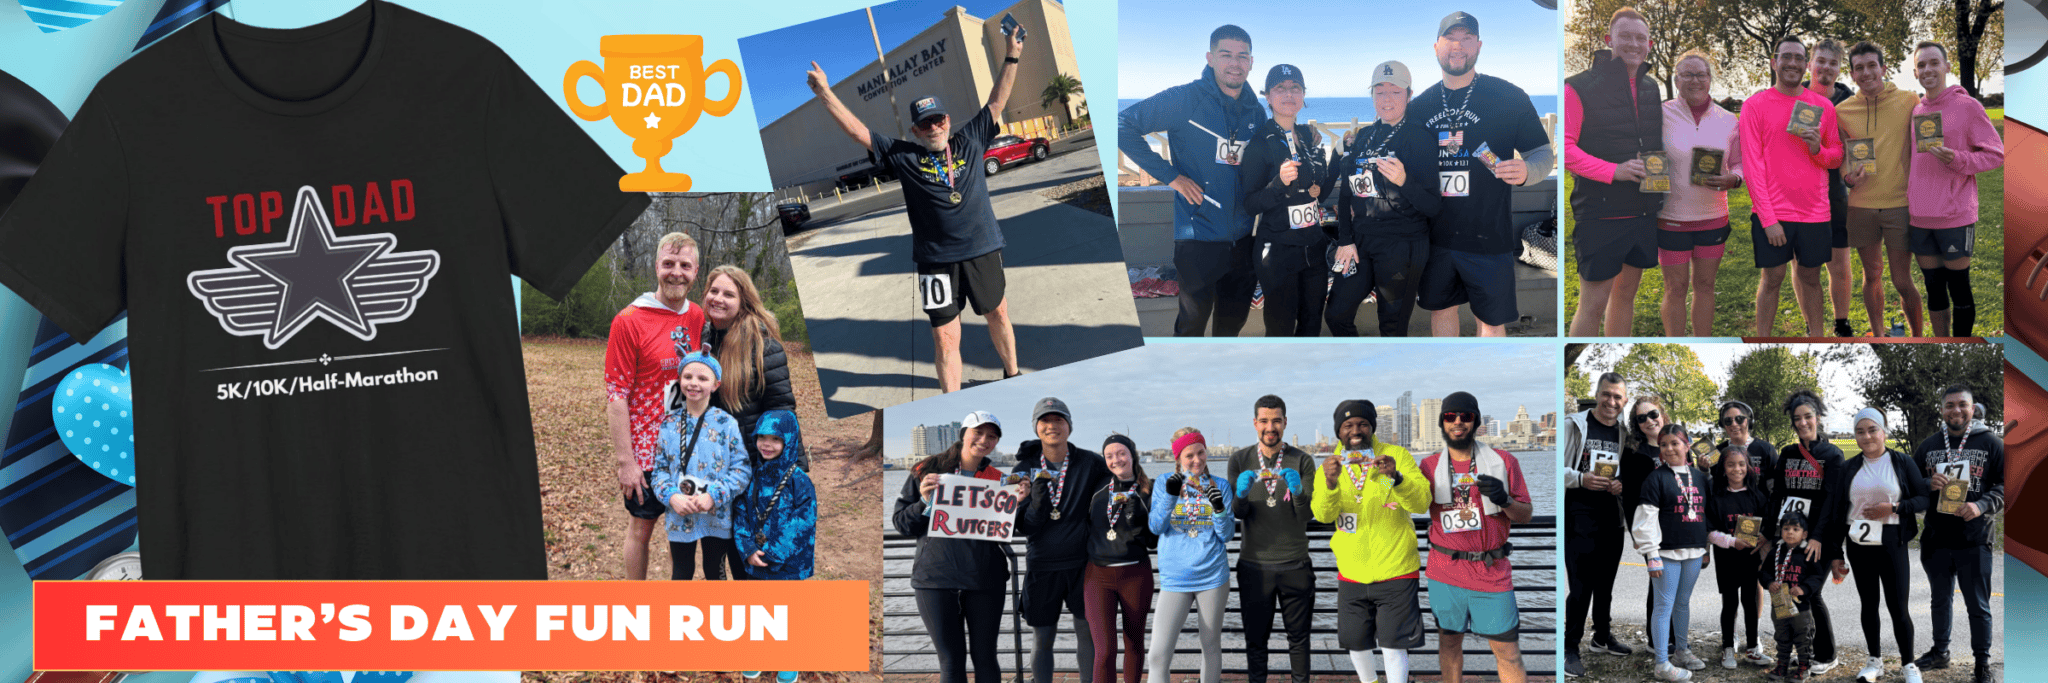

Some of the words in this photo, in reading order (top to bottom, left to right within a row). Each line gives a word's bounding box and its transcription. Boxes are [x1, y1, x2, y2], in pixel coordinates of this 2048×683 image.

[921, 38, 946, 62] BAY
[912, 55, 946, 77] CENTER
[1463, 109, 1481, 124] RUN
[1441, 174, 1467, 193] 70
[206, 191, 284, 238] TOP
[332, 179, 416, 227] DAD
[921, 277, 945, 305] 10
[216, 366, 439, 401] 5K/10K/Half-Marathon
[935, 484, 995, 509] LET'S
[994, 490, 1018, 514] GO
[931, 509, 1012, 539] RUTGERS
[1443, 511, 1479, 530] 038
[1859, 522, 1871, 543] 2
